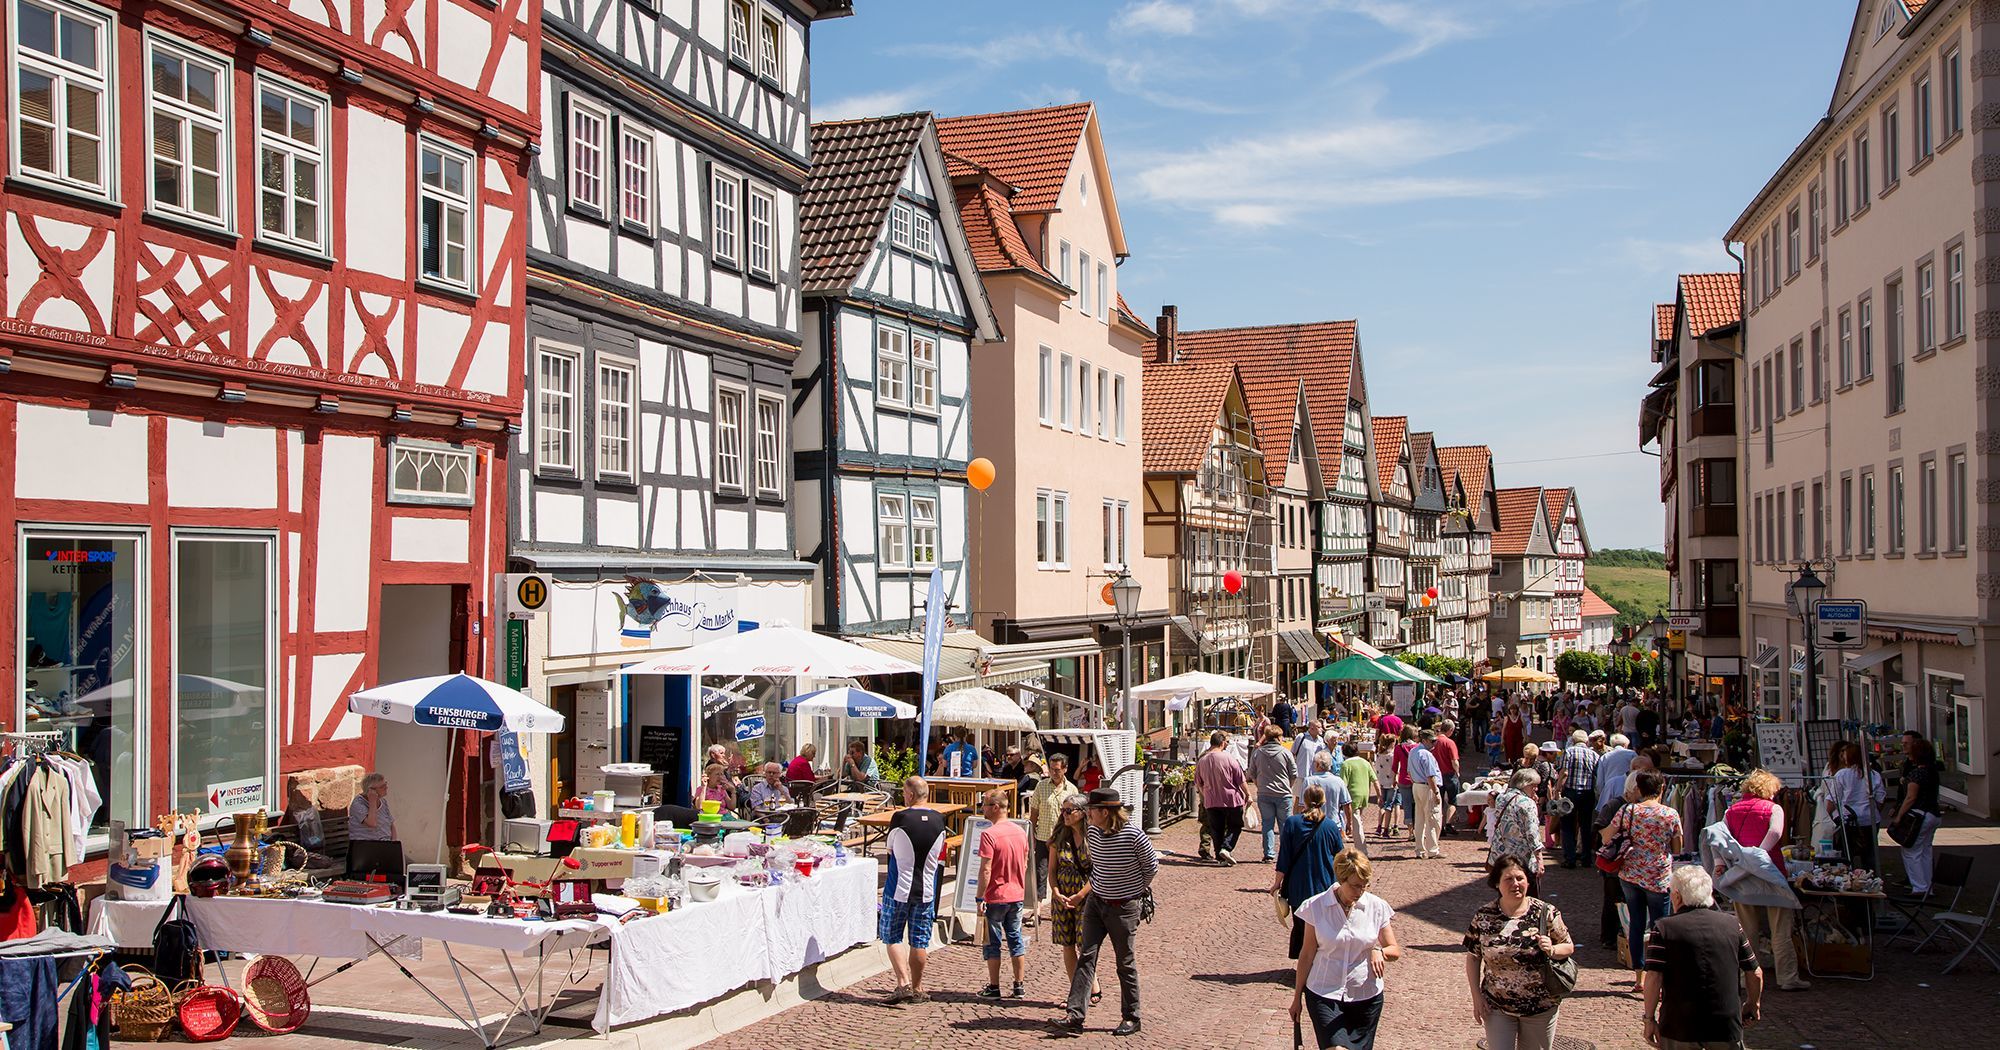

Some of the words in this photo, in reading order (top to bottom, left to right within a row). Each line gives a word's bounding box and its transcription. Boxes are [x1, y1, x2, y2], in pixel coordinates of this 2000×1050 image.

[58, 550, 117, 563] INTERSPORT
[525, 583, 540, 602] H
[702, 616, 713, 627] am
[714, 609, 735, 626] Markt
[511, 628, 519, 677] Marktplatz
[429, 706, 488, 720] FLENSBURGER
[437, 716, 478, 728] PILSENER
[227, 784, 262, 796] INTERSPORT
[225, 796, 260, 806] KETTSCHAU
